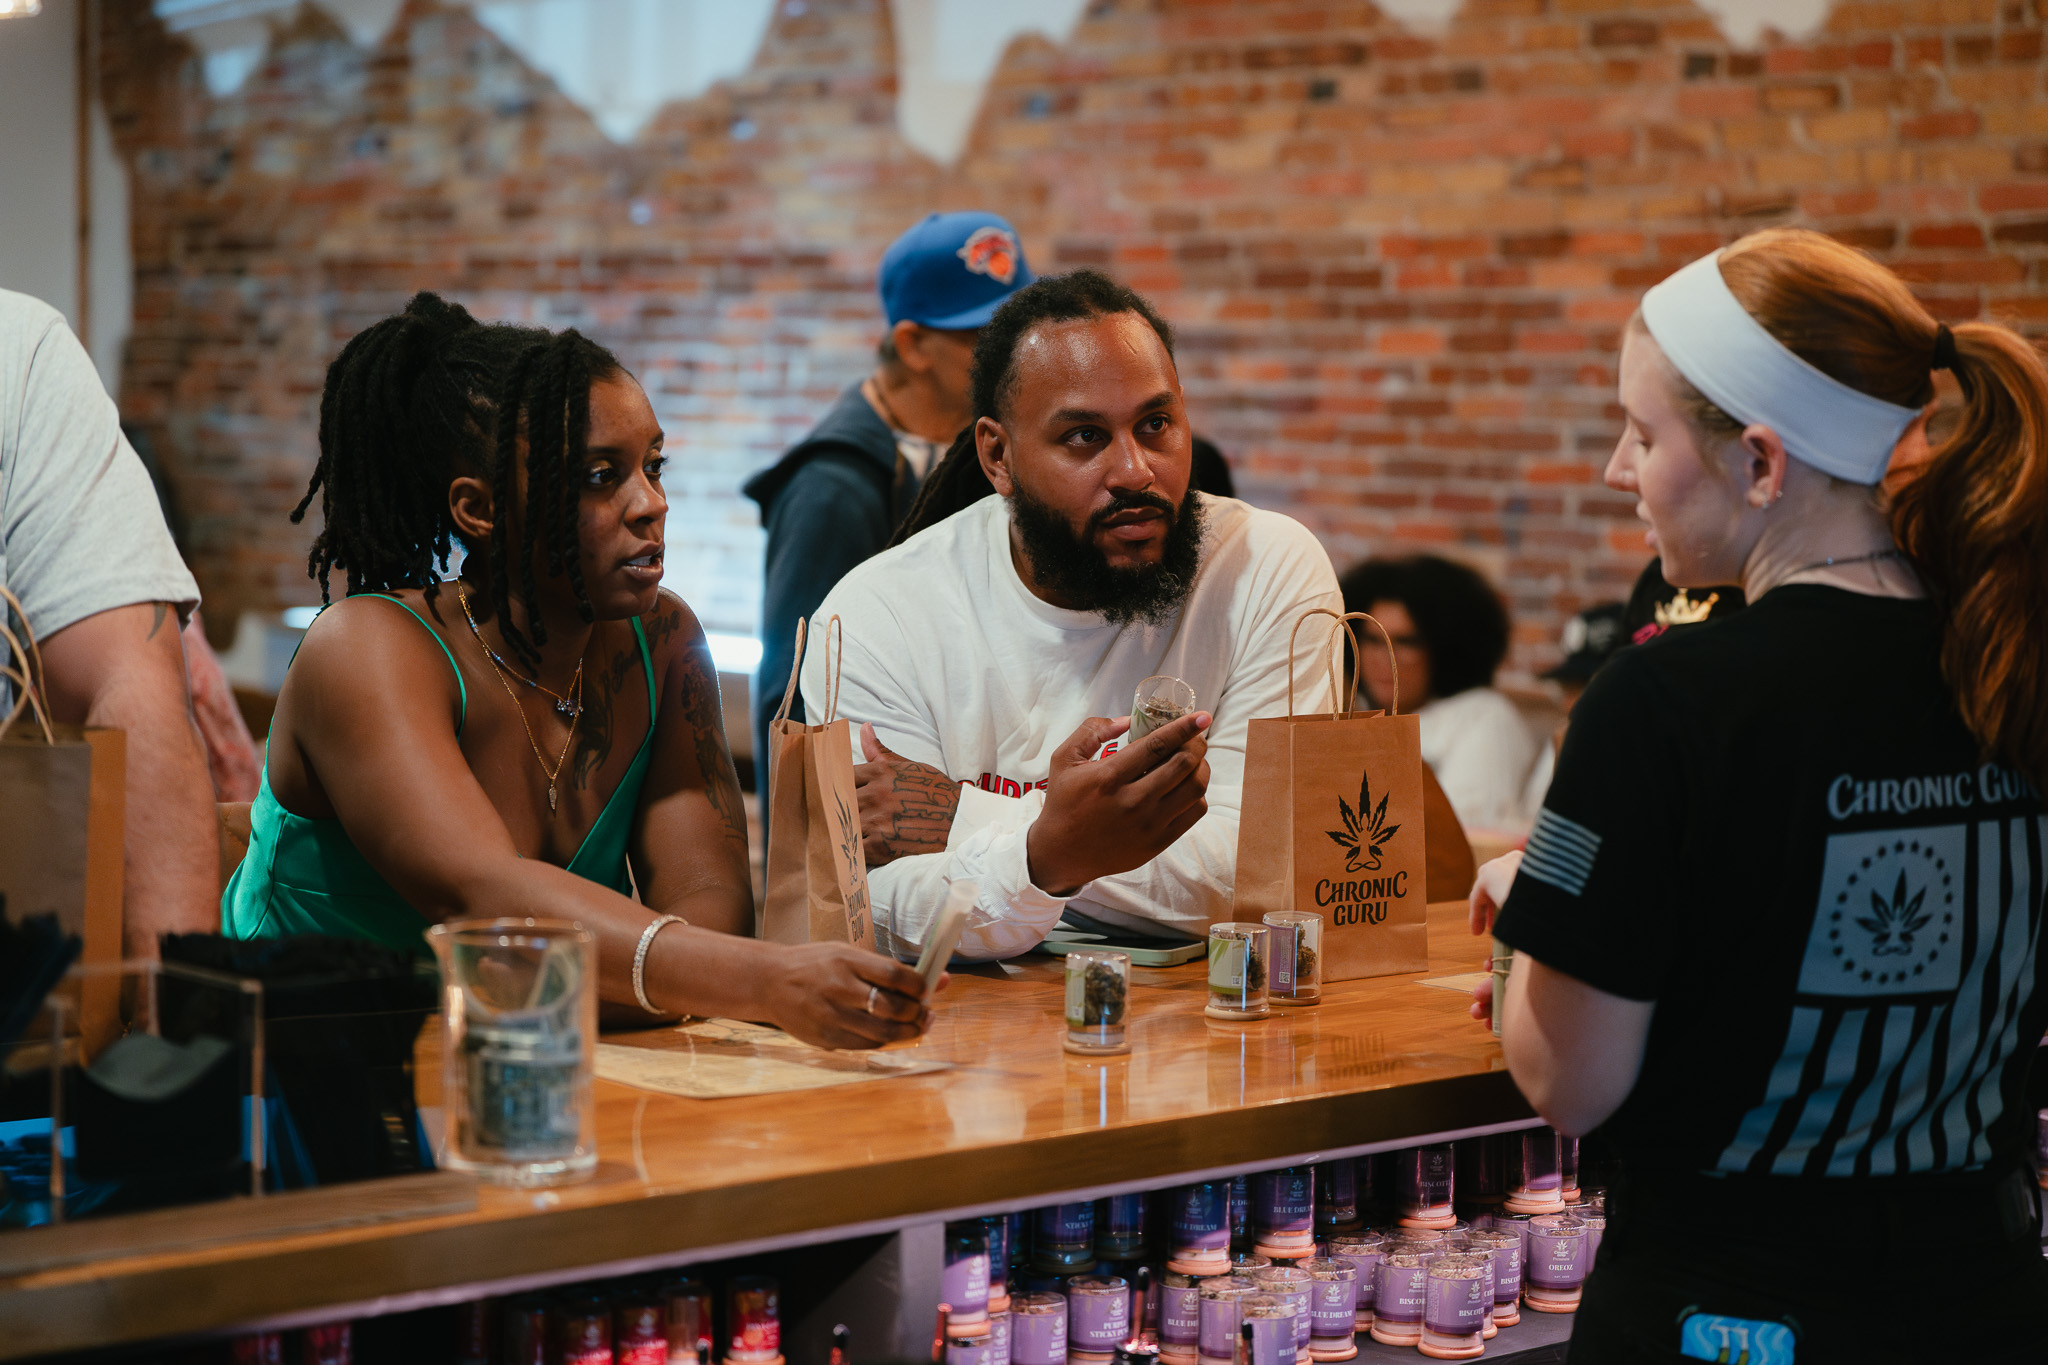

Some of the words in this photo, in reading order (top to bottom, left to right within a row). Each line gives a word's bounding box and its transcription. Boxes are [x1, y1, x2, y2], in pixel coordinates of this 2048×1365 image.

[1827, 773, 1974, 821] CHRONIC
[1314, 870, 1408, 907] CHRONIC
[1333, 901, 1388, 926] GURU
